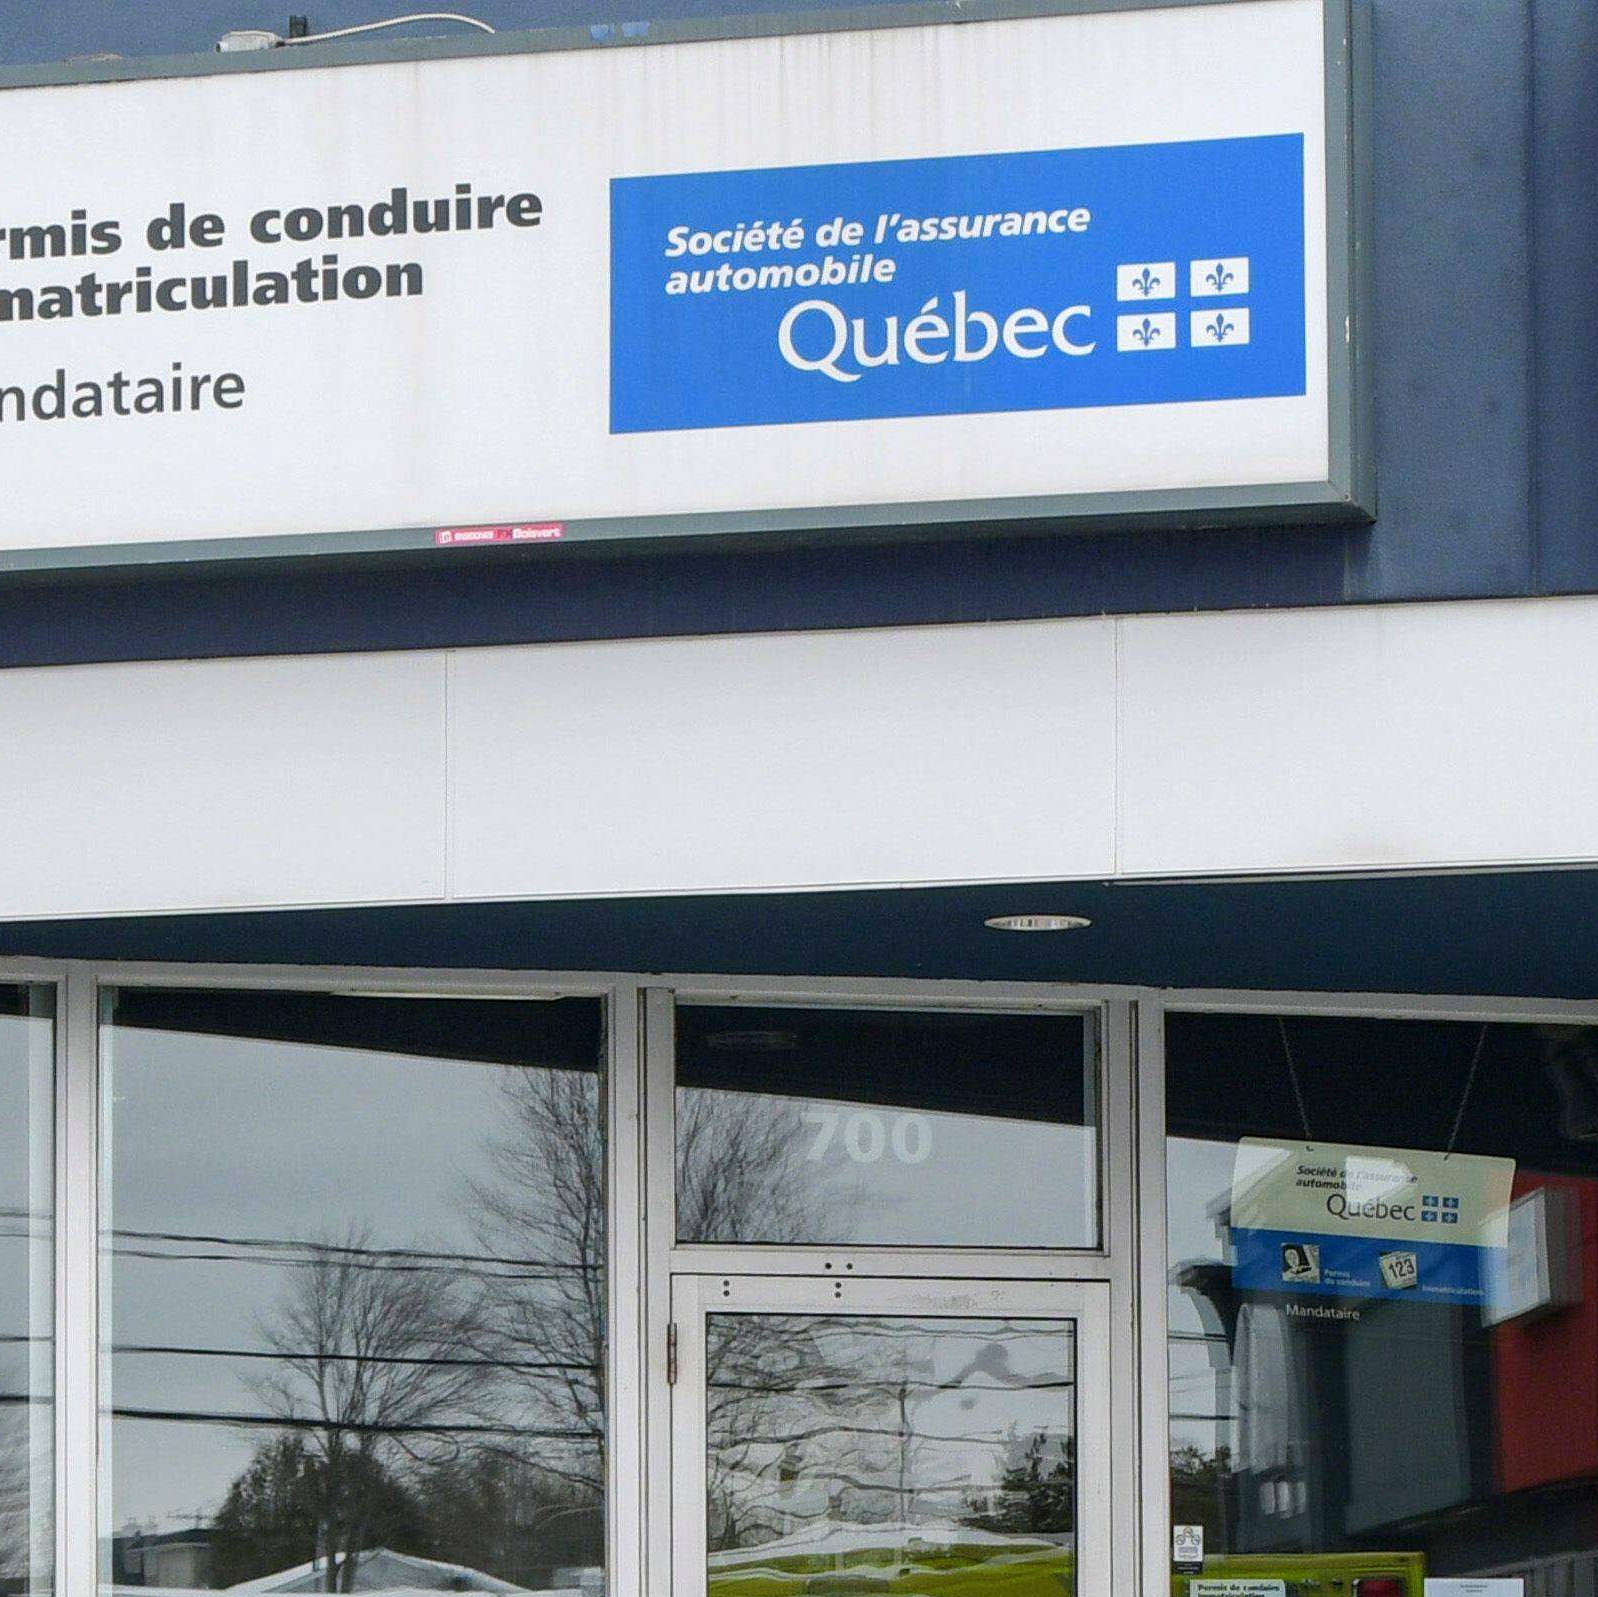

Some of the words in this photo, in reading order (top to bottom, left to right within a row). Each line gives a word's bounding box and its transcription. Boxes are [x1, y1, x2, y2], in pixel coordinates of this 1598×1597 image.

[146, 202, 225, 251] de
[250, 183, 543, 244] conduire
[664, 217, 804, 257] Société
[815, 217, 864, 248] de
[873, 207, 1092, 245] l'assurance
[664, 253, 897, 295] automobile
[778, 289, 1097, 383] Québec
[800, 1111, 933, 1164] 700
[1296, 1164, 1338, 1178] Société
[1326, 1192, 1416, 1221] Québec
[1388, 1258, 1415, 1279] 123
[1285, 1303, 1360, 1320] Mandataire
